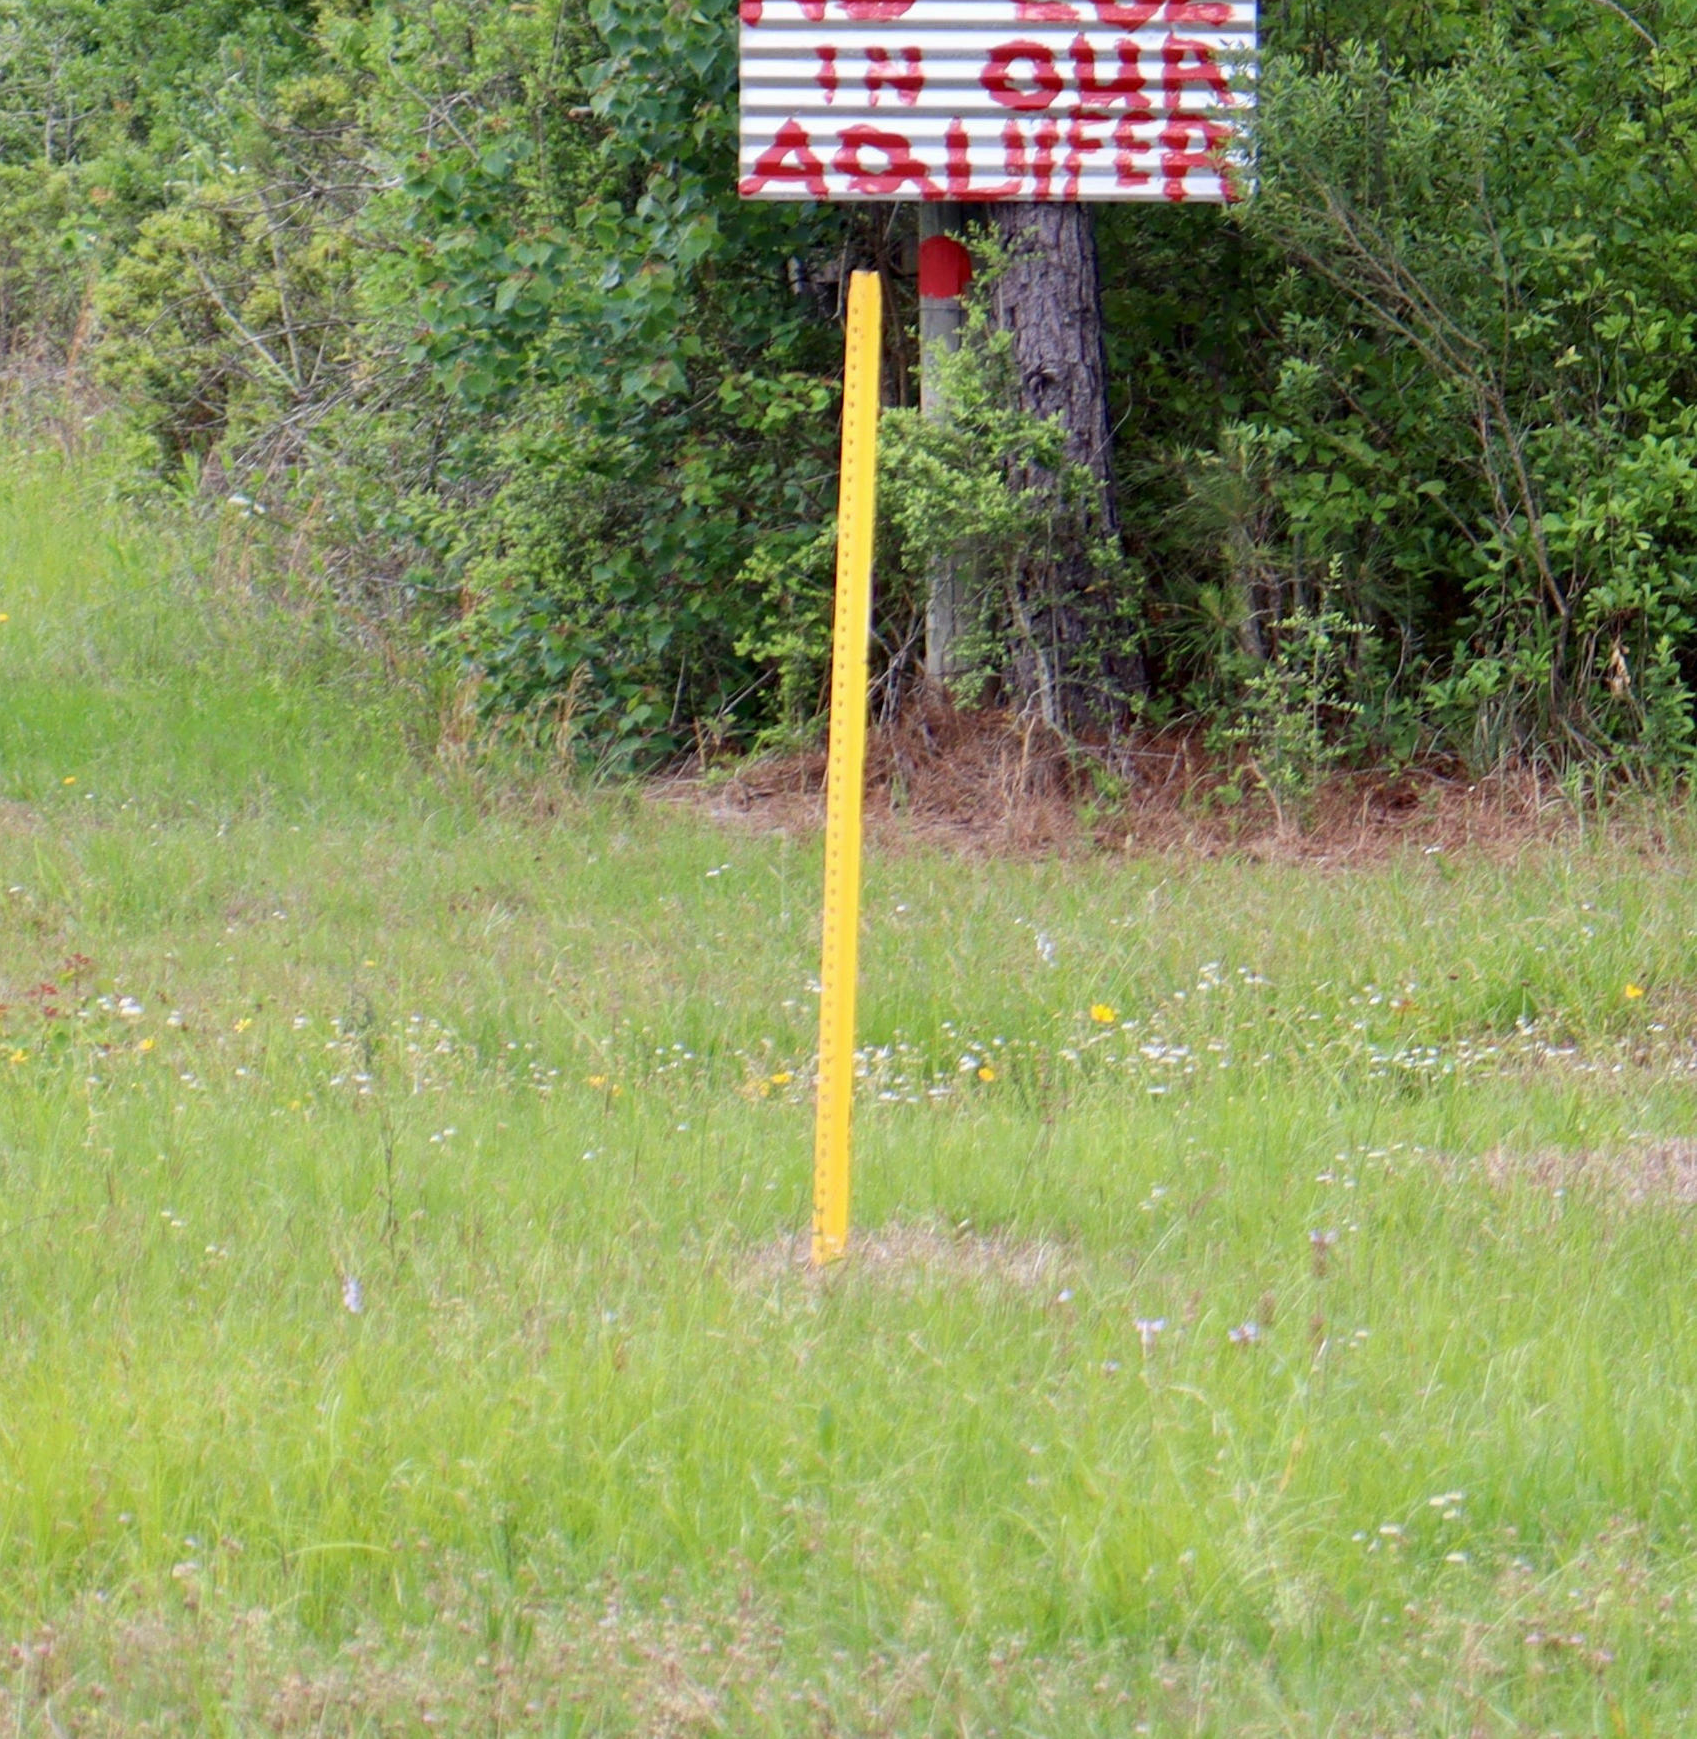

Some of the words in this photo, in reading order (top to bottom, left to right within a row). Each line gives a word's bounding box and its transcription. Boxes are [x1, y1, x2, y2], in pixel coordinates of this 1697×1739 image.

[816, 45, 924, 107] IN
[980, 32, 1237, 110] OUR
[739, 108, 1245, 202] AQUIFER
